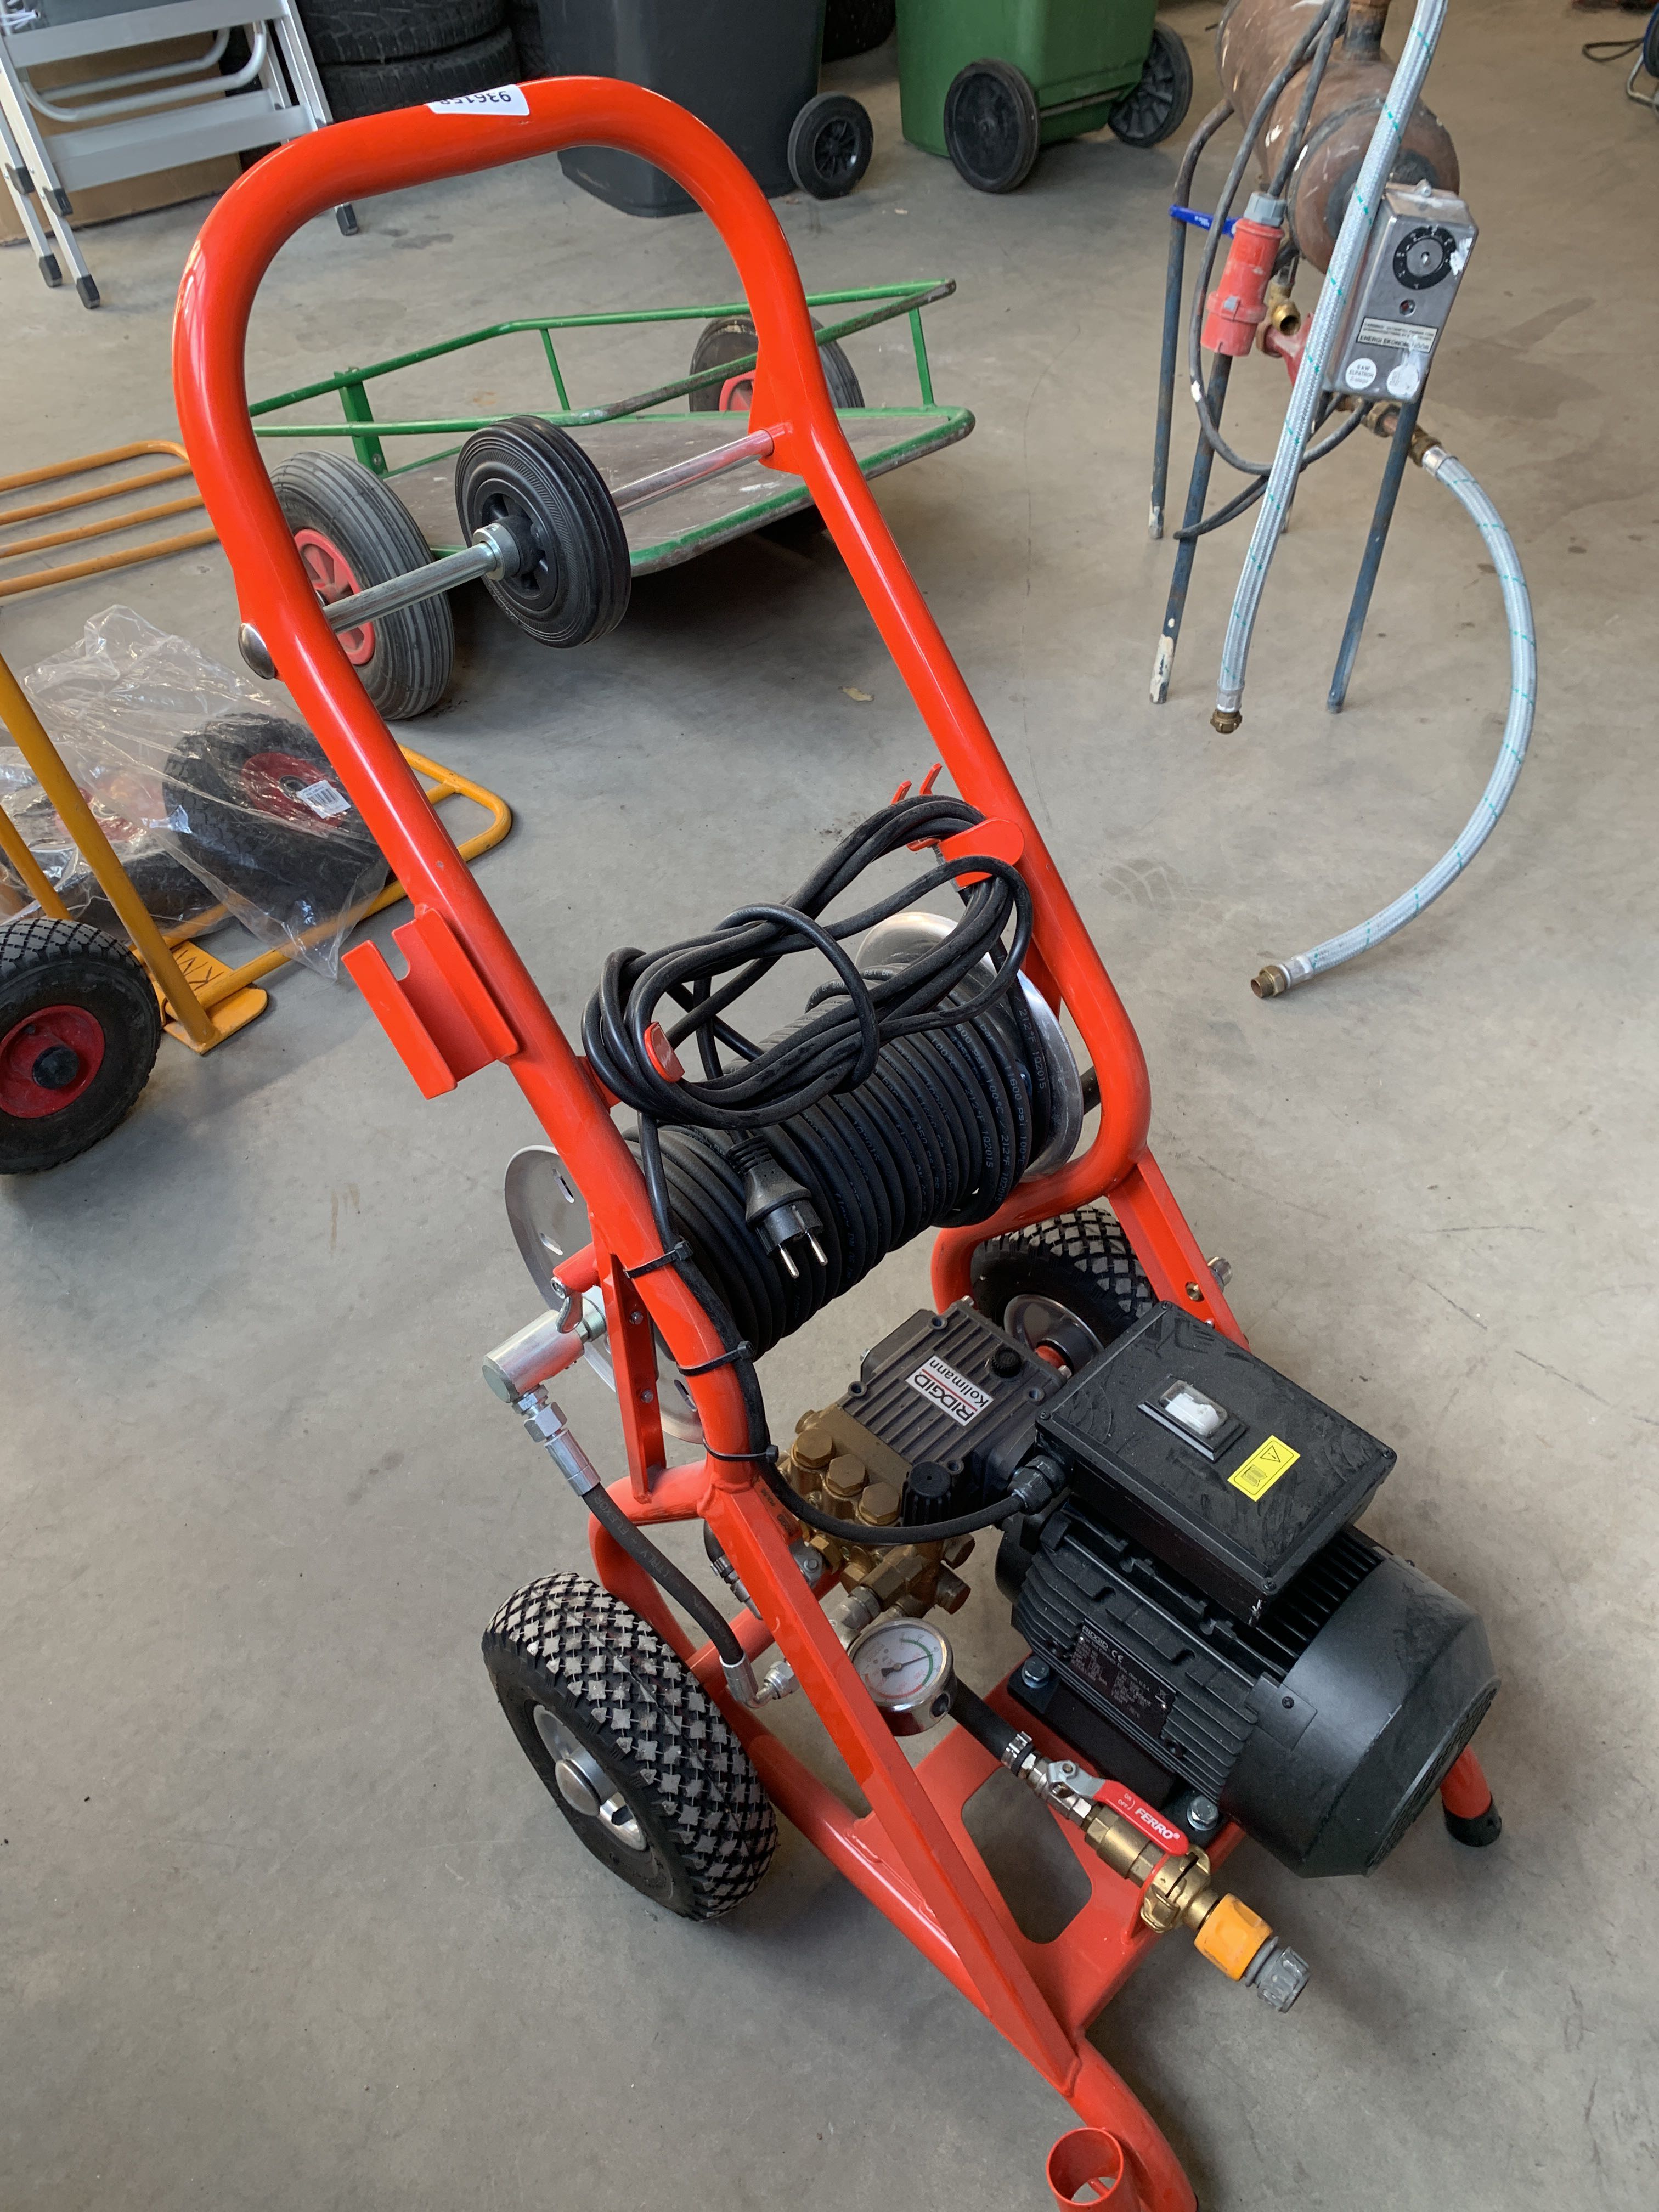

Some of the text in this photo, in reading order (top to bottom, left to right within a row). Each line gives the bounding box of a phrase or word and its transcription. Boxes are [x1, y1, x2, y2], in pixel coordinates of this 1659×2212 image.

[1032, 1051, 1047, 1090] 102015
[981, 1131, 994, 1169] 102015
[913, 1372, 975, 1421] RIDGID
[929, 1358, 989, 1408] Kollmann
[1081, 1624, 1109, 1649] RIDGID
[1124, 1792, 1133, 1802] ON
[1134, 1807, 1174, 1840] FERRO
